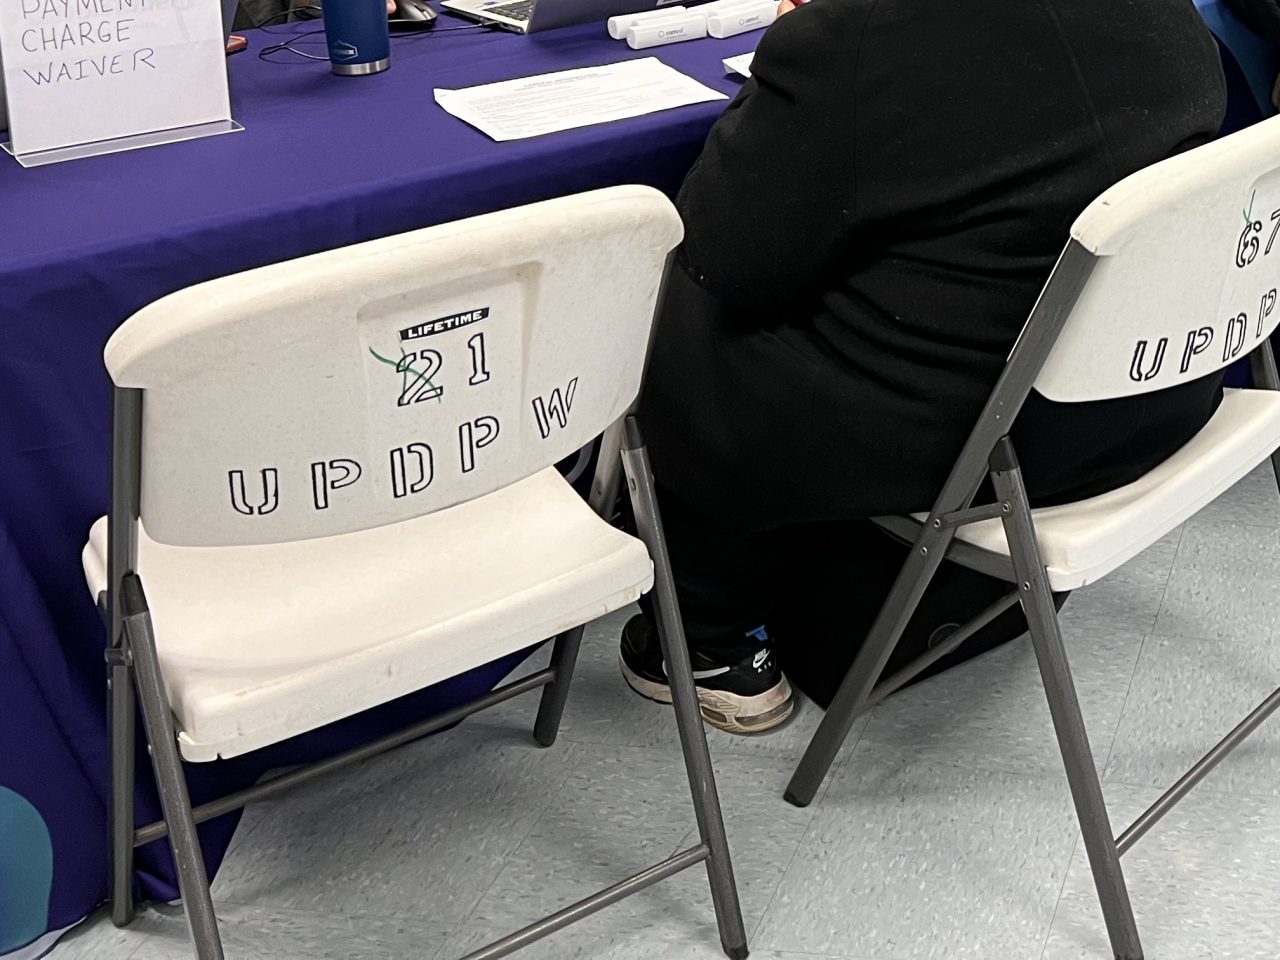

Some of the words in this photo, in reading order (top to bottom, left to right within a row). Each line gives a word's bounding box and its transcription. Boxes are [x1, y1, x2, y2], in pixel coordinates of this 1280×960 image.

[21, 18, 136, 54] CHARGE
[23, 47, 156, 86] WAIVER
[407, 310, 483, 339] LIFETIME
[395, 332, 491, 407] 21
